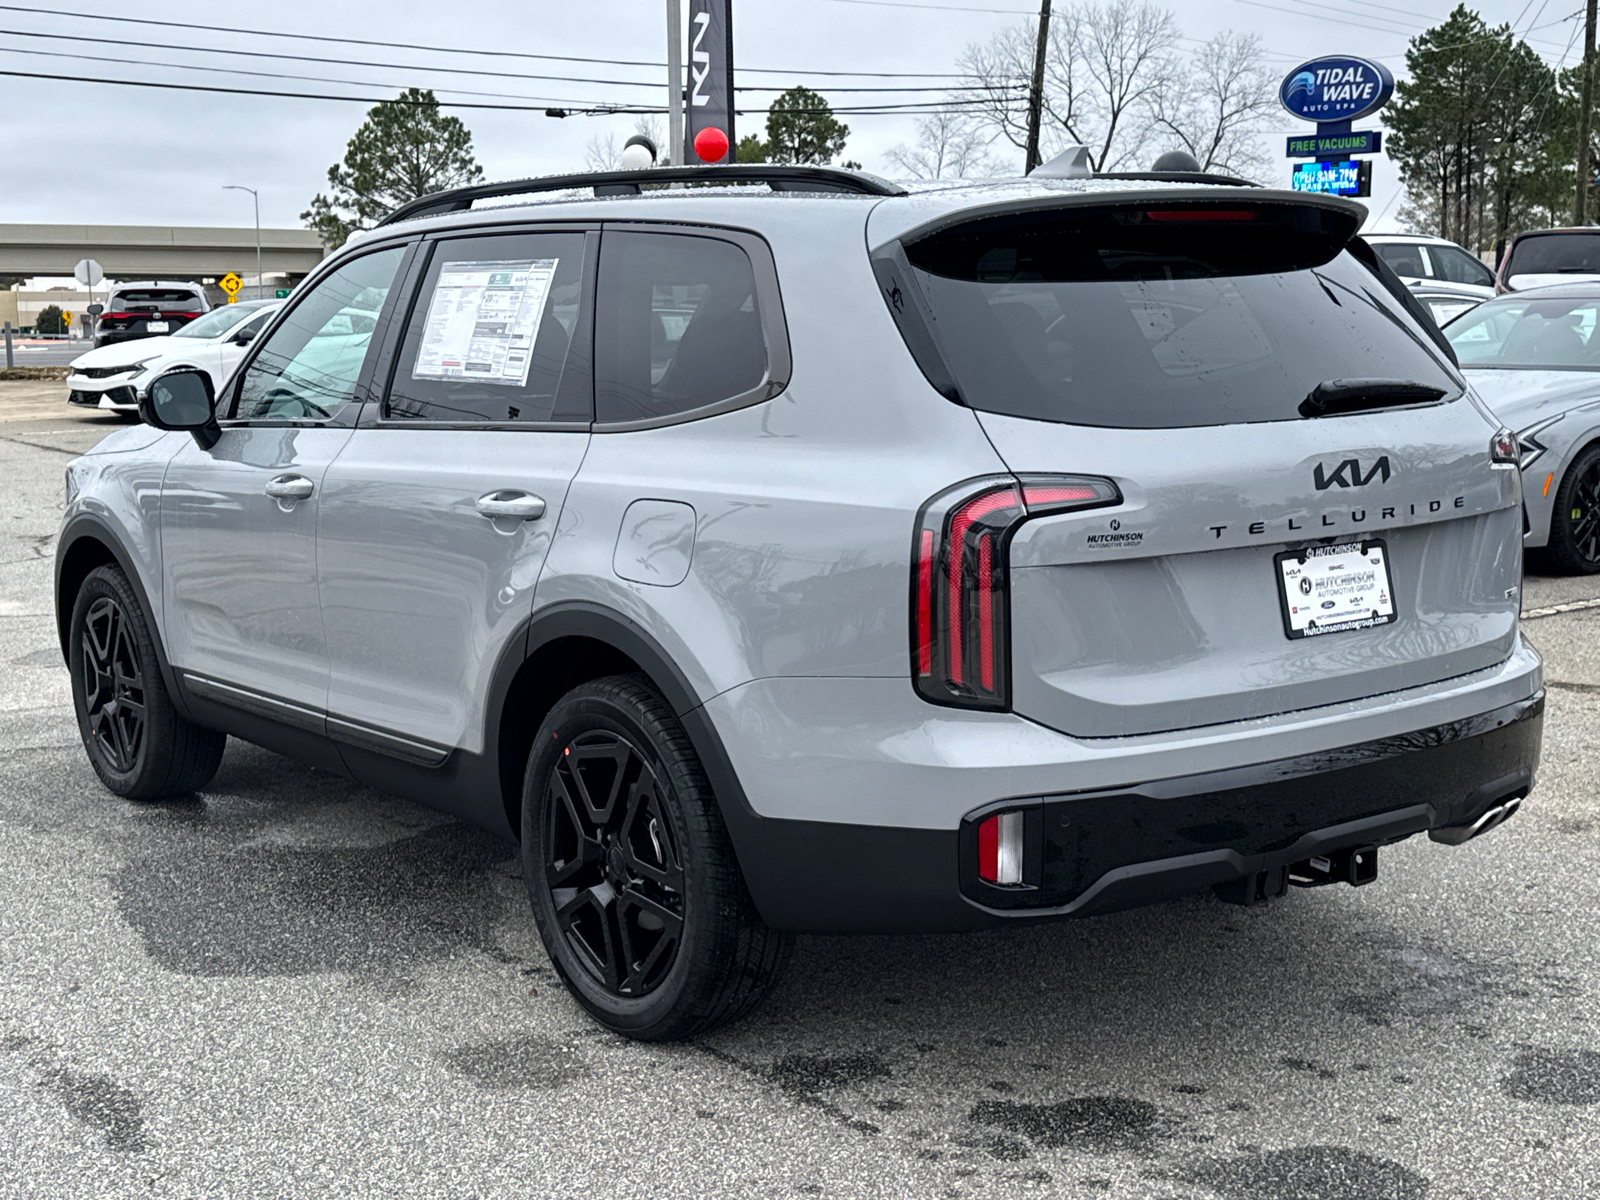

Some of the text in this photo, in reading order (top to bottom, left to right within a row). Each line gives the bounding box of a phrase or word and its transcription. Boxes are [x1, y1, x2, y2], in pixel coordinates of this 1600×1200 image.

[1316, 66, 1364, 85] TIDAL
[1323, 82, 1375, 102] WAVE
[1302, 104, 1329, 112] AUTO
[1290, 136, 1367, 152] FREE VACUUMS
[1209, 496, 1465, 538] TELLURIDE
[1087, 533, 1144, 543] HUTCHINSON
[1315, 542, 1363, 557] HUTCHINSON
[1315, 570, 1375, 590] HUTCHINSON
[1317, 583, 1375, 598] AUTOMOTIVE GROUP
[1303, 616, 1389, 636] Hutchinsonautogroup.com
